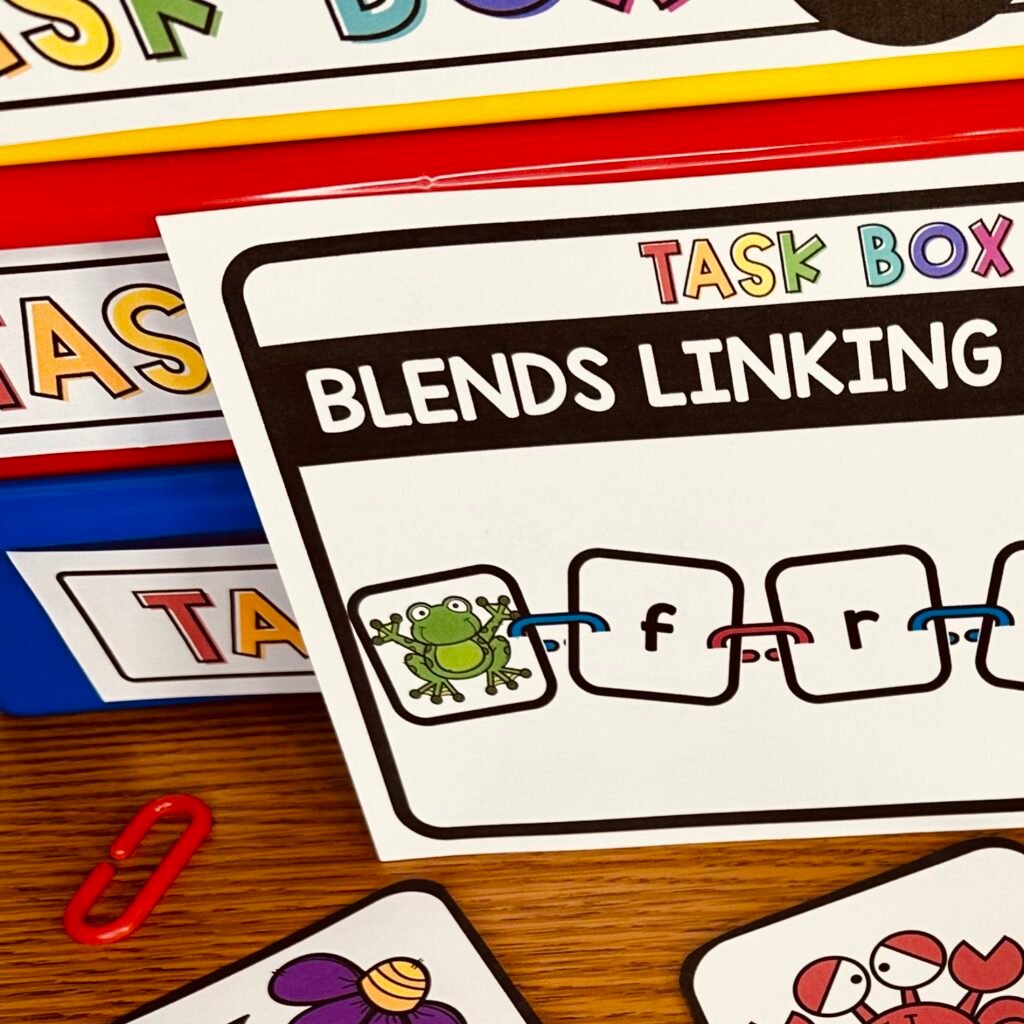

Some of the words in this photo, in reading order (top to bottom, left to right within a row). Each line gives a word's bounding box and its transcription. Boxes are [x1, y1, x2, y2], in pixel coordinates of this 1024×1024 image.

[638, 229, 826, 304] TASK
[857, 213, 1014, 288] BOX
[305, 346, 616, 434] BLENDS
[638, 318, 1002, 408] LINKING
[640, 602, 677, 652] f
[843, 609, 880, 650] r
